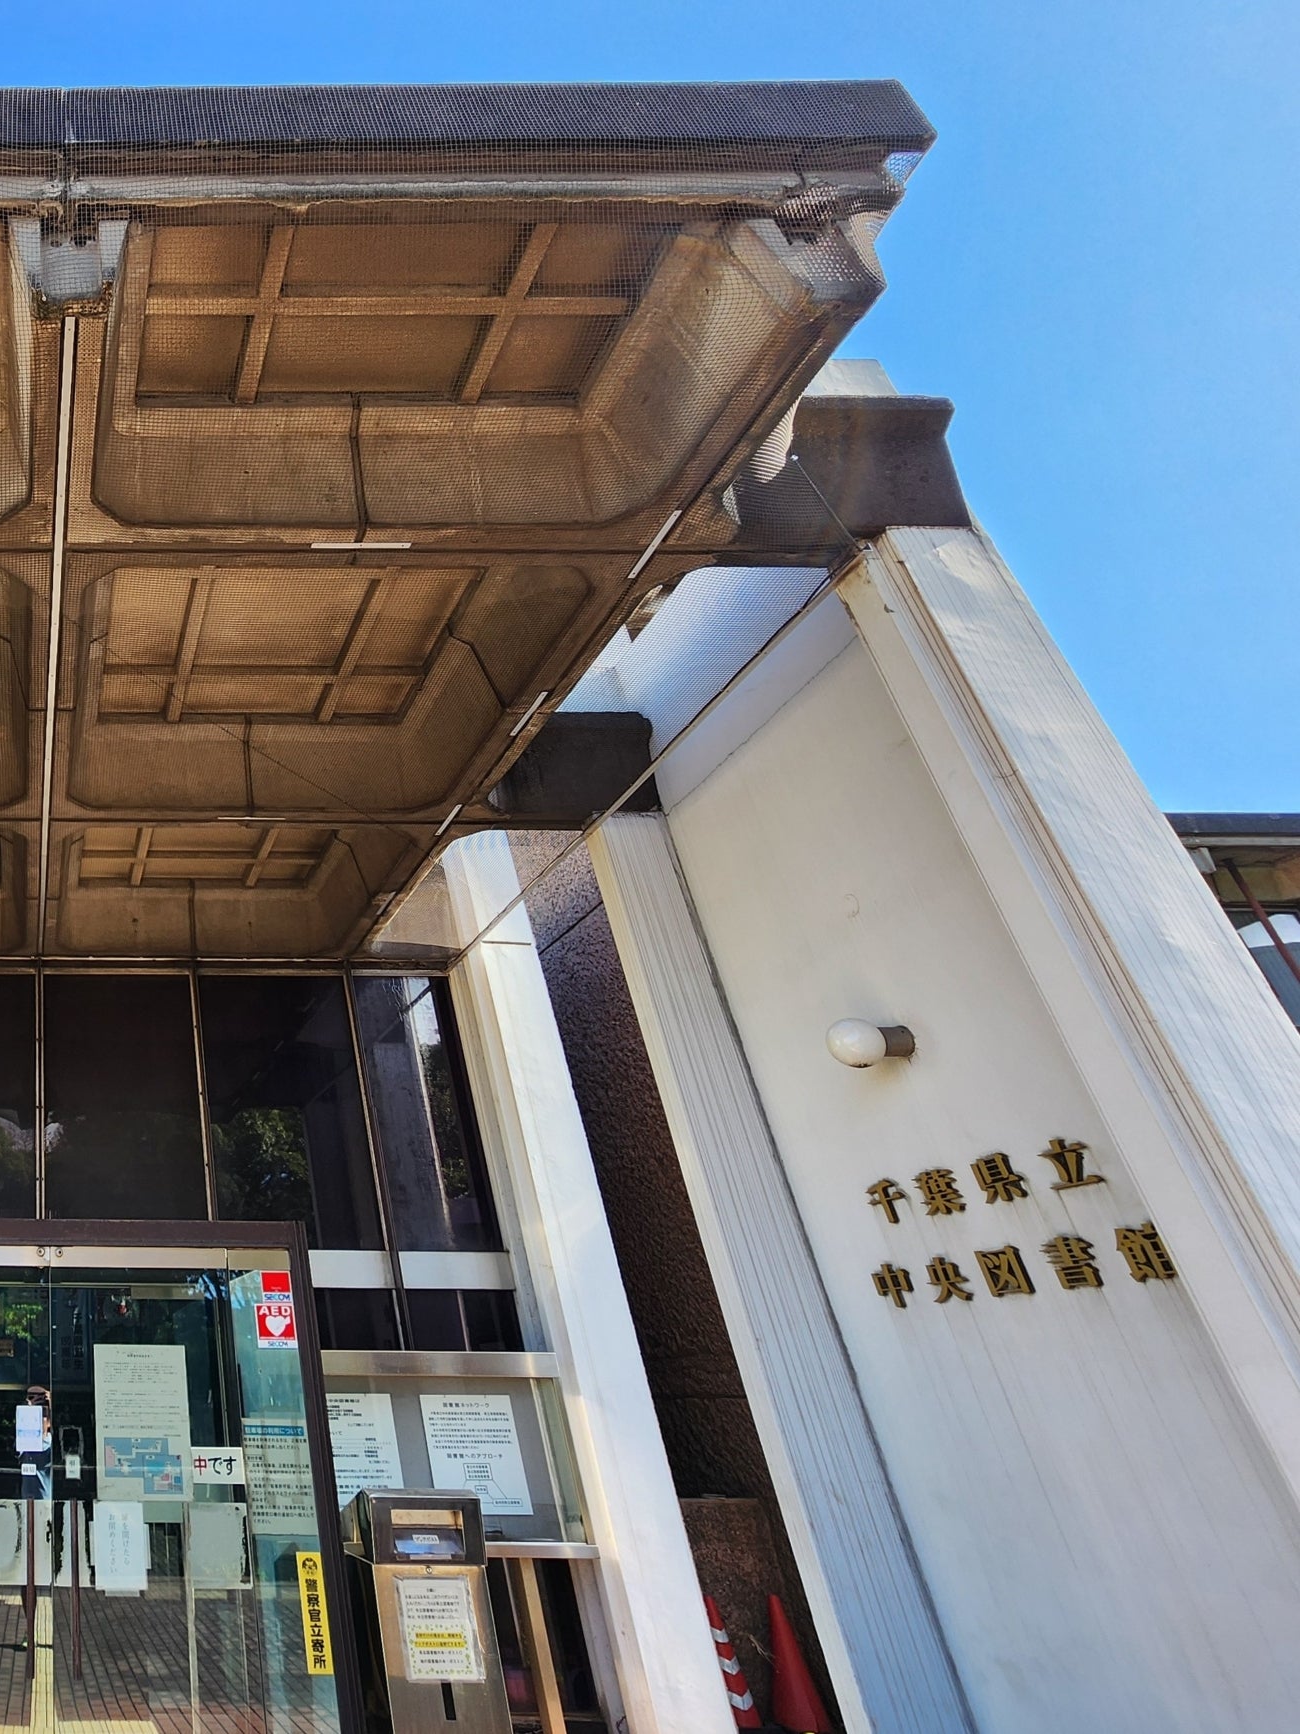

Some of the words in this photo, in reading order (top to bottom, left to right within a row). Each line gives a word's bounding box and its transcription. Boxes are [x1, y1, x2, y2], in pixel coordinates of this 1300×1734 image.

[865, 1137, 1106, 1224] 千葉県立
[871, 1221, 1178, 1309] 中央図書館
[259, 1306, 291, 1316] AED
[264, 1293, 291, 1301] SECOM
[193, 1454, 237, 1476] 中です
[305, 1578, 326, 1669] 警察官立寄所
